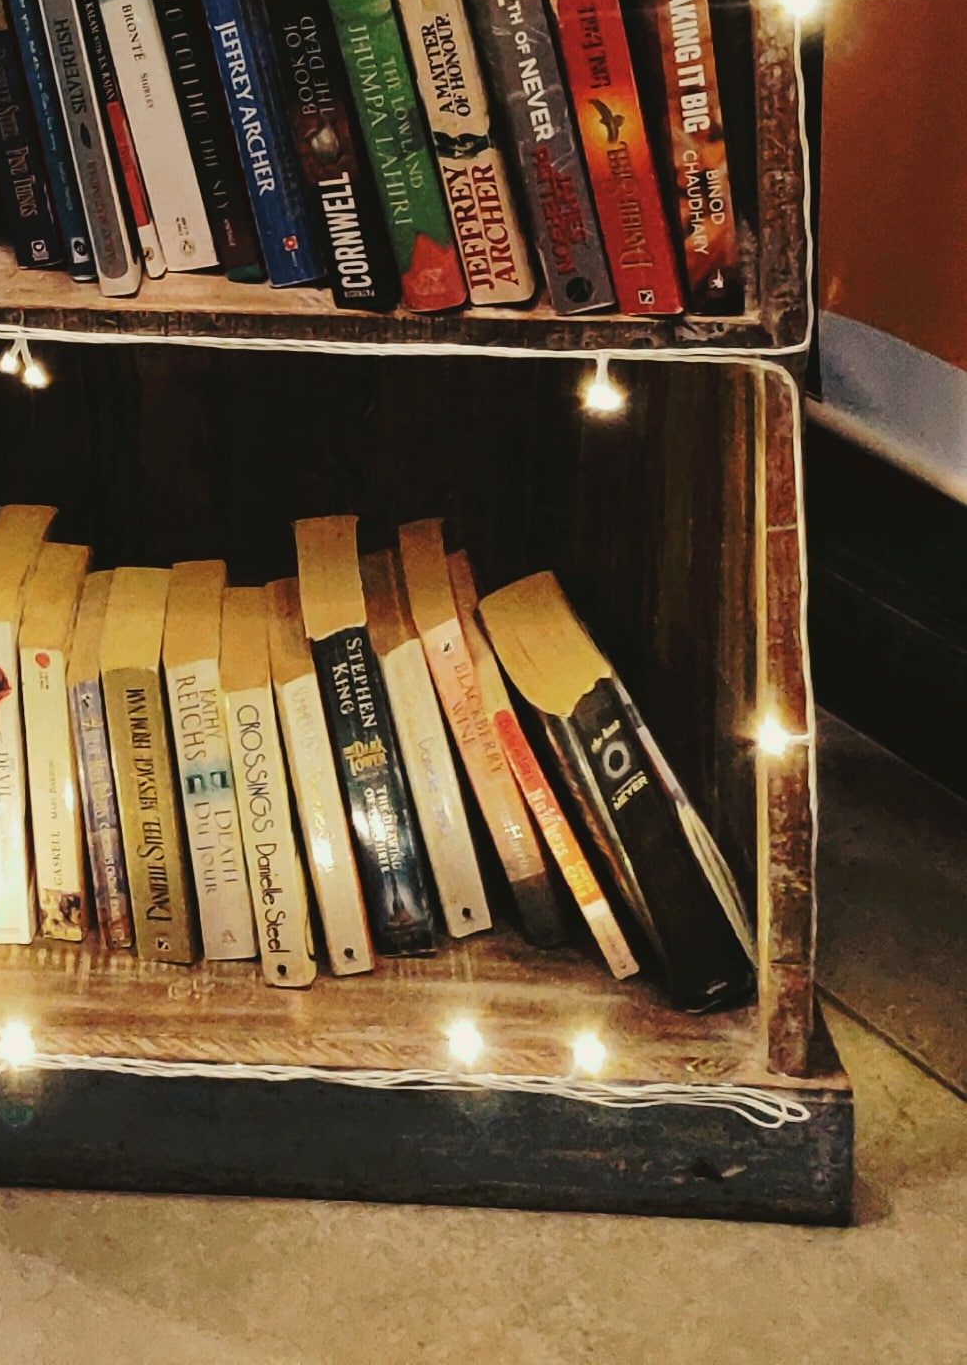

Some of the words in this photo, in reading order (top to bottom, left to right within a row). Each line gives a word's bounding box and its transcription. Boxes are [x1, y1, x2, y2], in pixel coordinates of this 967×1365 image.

[85, 1, 100, 34] KALAM
[284, 23, 302, 48] OF
[300, 16, 325, 71] DEAD
[514, 30, 531, 54] OF
[53, 18, 87, 115] SILVERFISH
[292, 57, 317, 116] BOOK
[382, 56, 401, 92] THE
[421, 23, 451, 98] MATTER
[677, 65, 705, 90] IT
[214, 19, 254, 101] JEFFREY
[238, 105, 275, 197] ARCHER
[314, 80, 335, 118] THE
[348, 23, 388, 128] JHUMPA
[376, 135, 413, 226] LAHIRI
[437, 99, 455, 115] A
[454, 95, 471, 118] OF
[518, 57, 555, 144] NEVER
[681, 91, 711, 134] BIG
[390, 96, 423, 190] LOWLAND
[12, 175, 38, 219] THINGS
[471, 163, 520, 287] ARCHER
[533, 143, 576, 276] PATTERSON
[683, 149, 710, 256] CHAUDHARY
[704, 168, 725, 226] BINOD
[319, 171, 374, 289] CORNWELL
[442, 165, 495, 291] JEFFREY
[126, 688, 149, 718] NAM
[332, 663, 355, 715] KING
[346, 637, 378, 728] STEPHEN
[129, 718, 152, 750] FROM
[175, 674, 207, 762] REICHS
[200, 688, 223, 740] KATHY
[134, 757, 160, 811] MESSAGE
[237, 704, 274, 834] CROSSINGS
[51, 830, 63, 886] GASKELL
[136, 816, 164, 863] STEEL
[214, 809, 239, 884] DEATH
[146, 861, 172, 921] DANIELLE
[255, 843, 283, 906] Danielle
[264, 906, 291, 955] Steel
